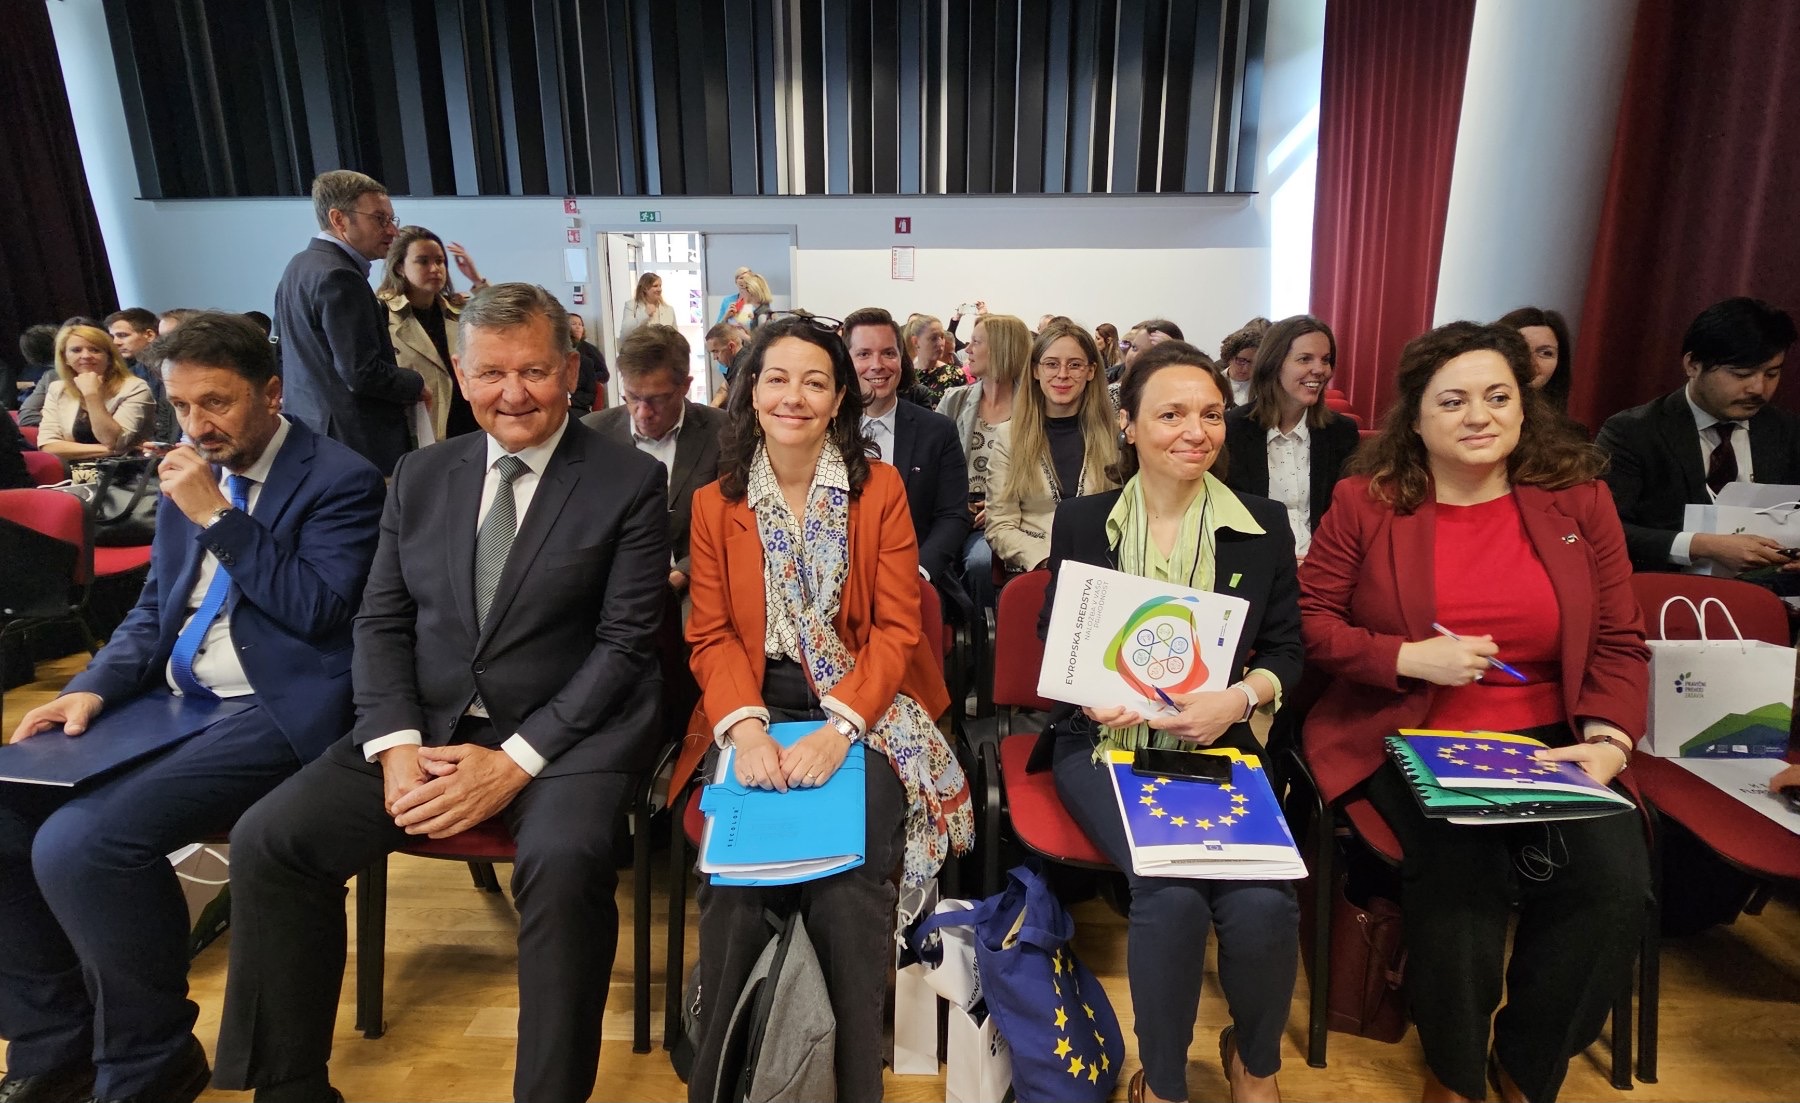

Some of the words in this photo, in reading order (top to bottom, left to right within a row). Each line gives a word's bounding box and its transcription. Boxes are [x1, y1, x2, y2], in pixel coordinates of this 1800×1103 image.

[1065, 631, 1081, 685] EVROPSKA
[1076, 578, 1094, 629] SREDSTVA
[1084, 607, 1097, 640] NALOŽBA
[1093, 579, 1103, 599] VAŠO
[1093, 581, 1109, 628] PRIHODNOST
